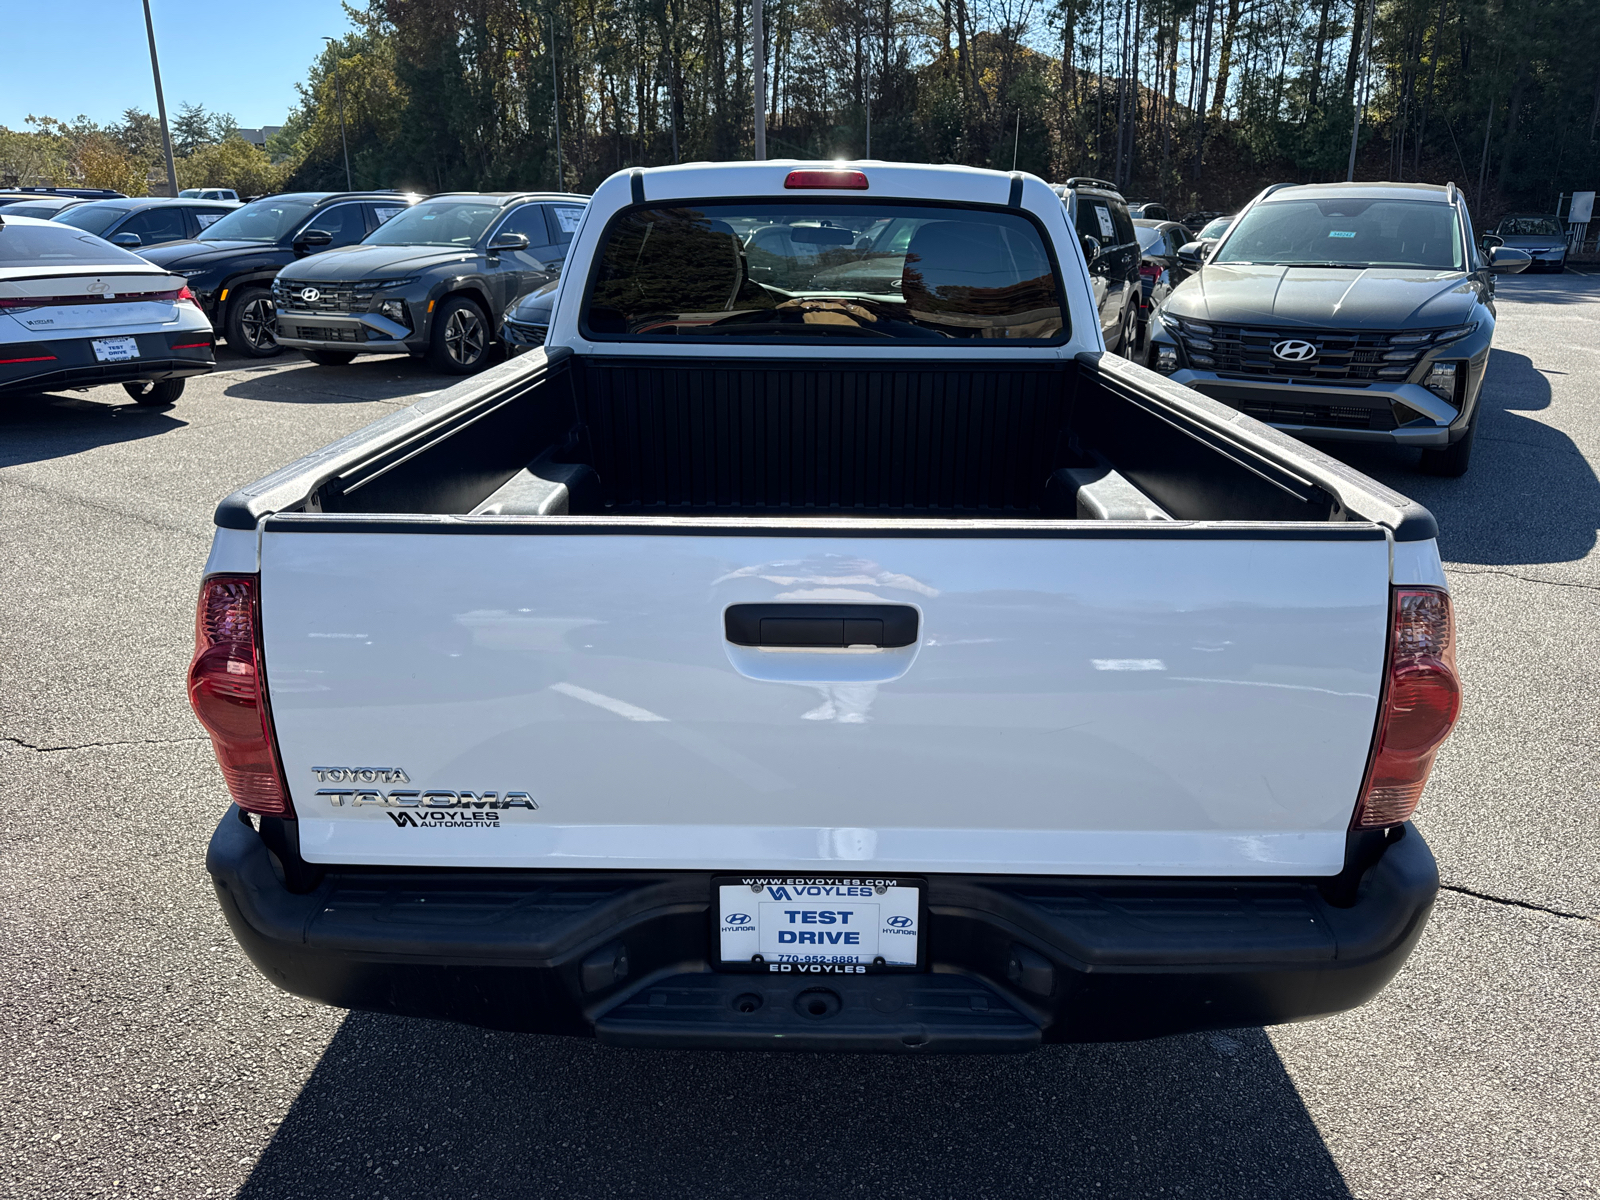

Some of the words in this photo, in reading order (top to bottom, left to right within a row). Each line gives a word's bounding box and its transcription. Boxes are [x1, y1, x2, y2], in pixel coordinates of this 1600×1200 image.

[57, 306, 147, 315] ELANTRA
[311, 766, 411, 784] TOYOTA
[314, 788, 539, 810] TACOMA
[415, 811, 500, 821] VOYLES
[742, 878, 897, 886] WWW.EDVOYLES.COM
[793, 886, 873, 897] VOYLES
[784, 910, 854, 925] TEST
[721, 925, 756, 933] HYUNDAI
[882, 928, 917, 936] HYUNDAI
[778, 930, 860, 945] DRIVE
[778, 954, 860, 964] 770-952-8881
[769, 964, 792, 972] ED
[797, 964, 867, 974] VOYLES
